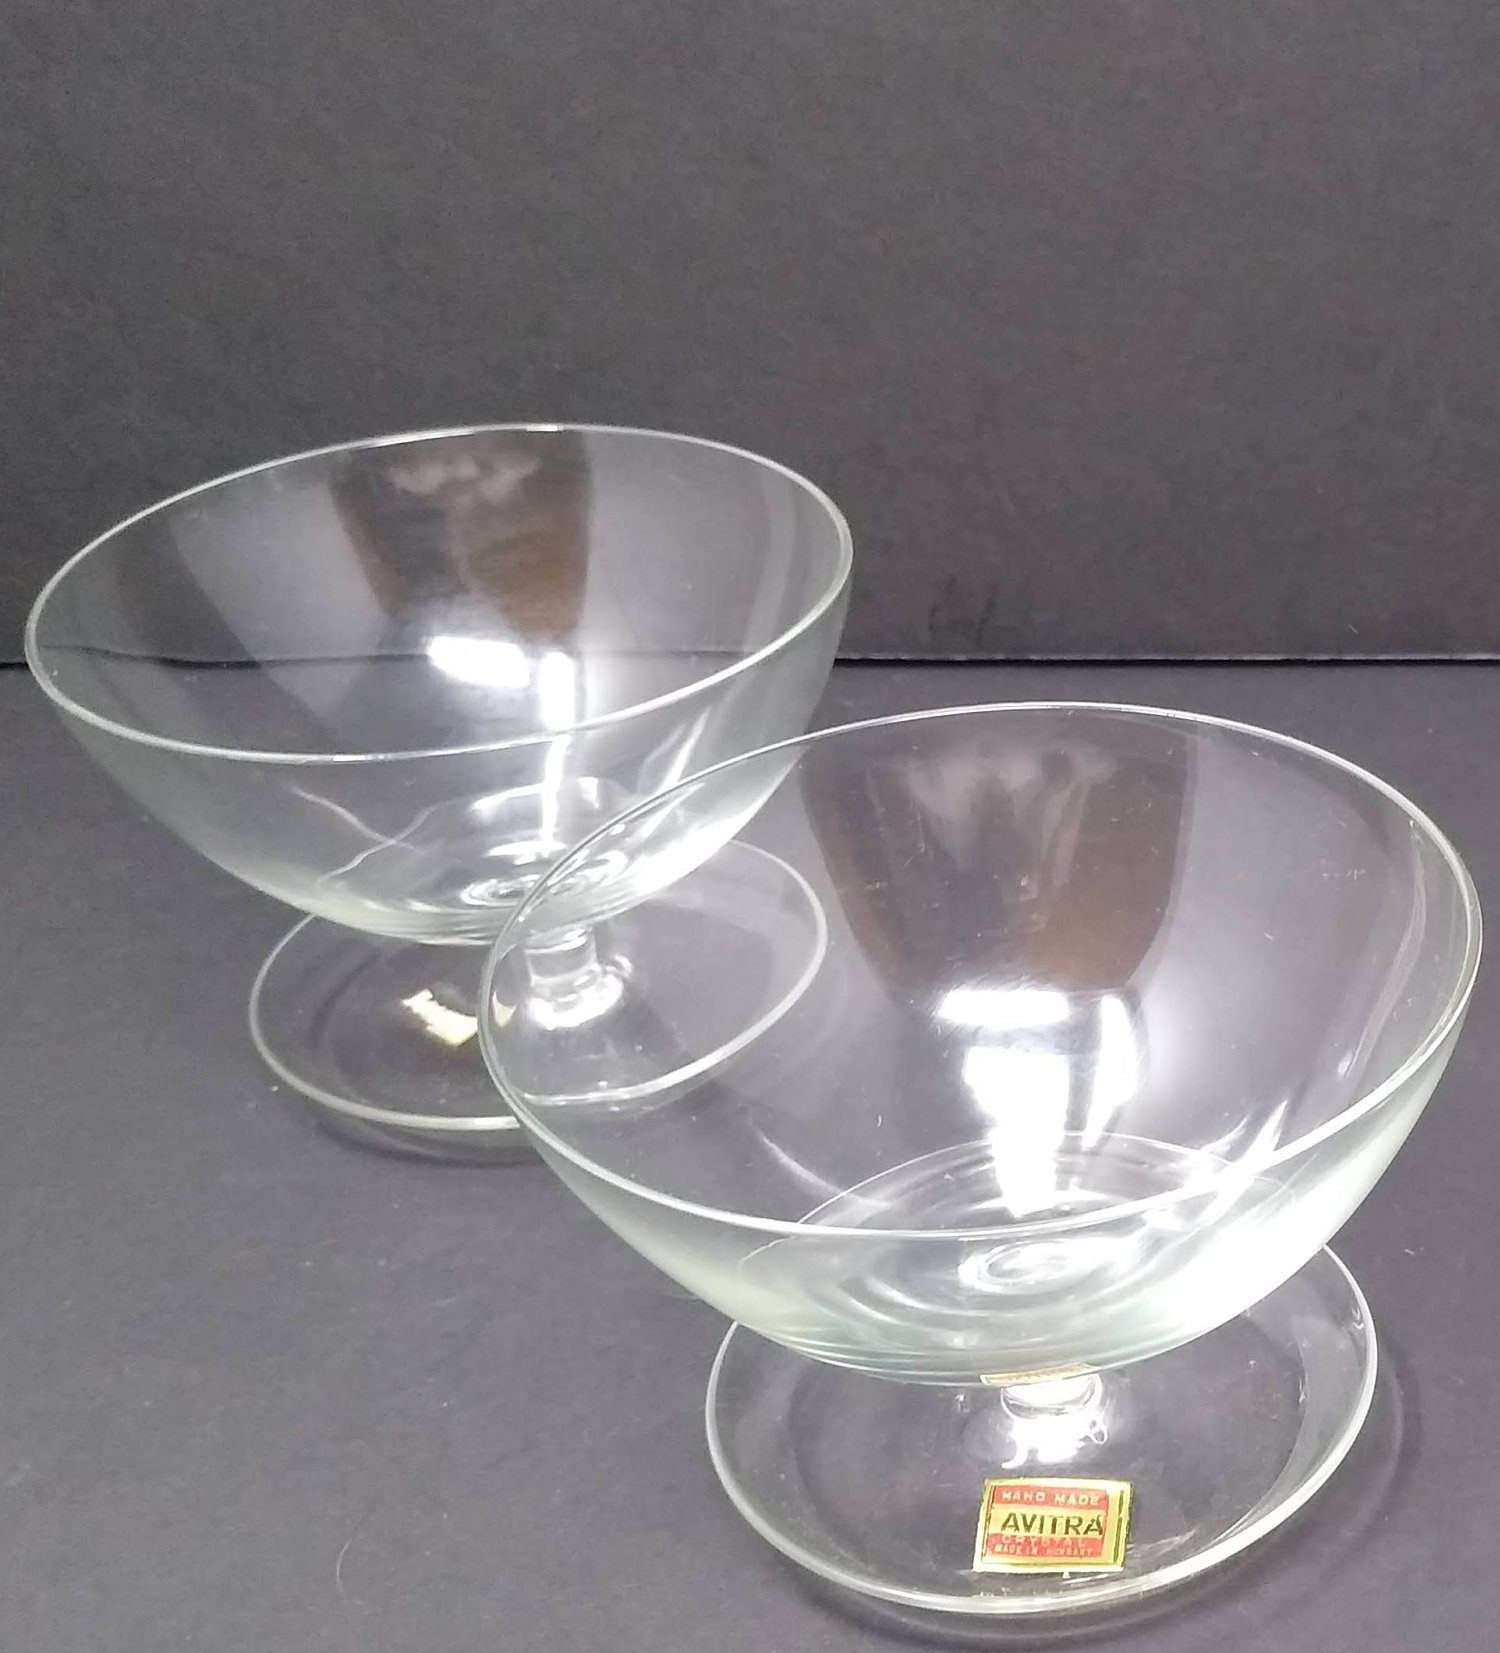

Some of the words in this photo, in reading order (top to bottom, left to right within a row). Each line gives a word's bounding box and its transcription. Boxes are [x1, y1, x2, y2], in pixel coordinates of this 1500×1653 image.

[1001, 1490, 1046, 1503] HAND
[1054, 1493, 1100, 1506] MADE
[1000, 1511, 1104, 1536] AVITRA
